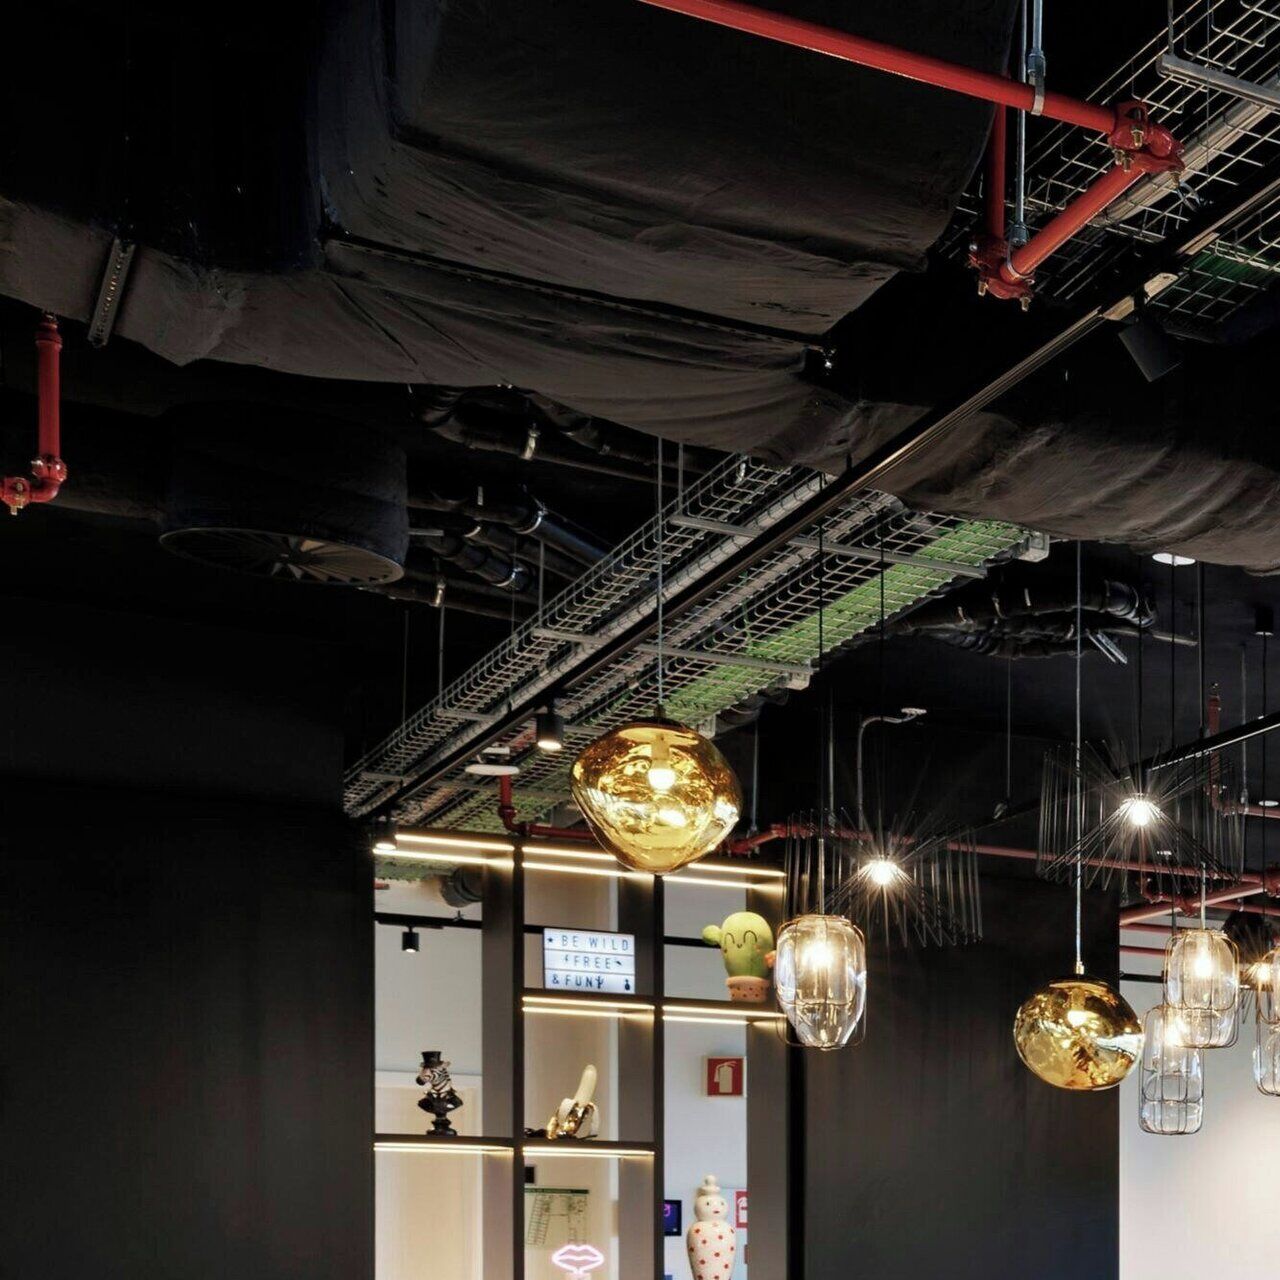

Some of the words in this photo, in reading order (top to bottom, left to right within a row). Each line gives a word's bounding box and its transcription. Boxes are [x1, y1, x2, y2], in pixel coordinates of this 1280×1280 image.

[561, 934, 579, 948] BE
[589, 937, 629, 951] WILD
[573, 955, 611, 969] FREE
